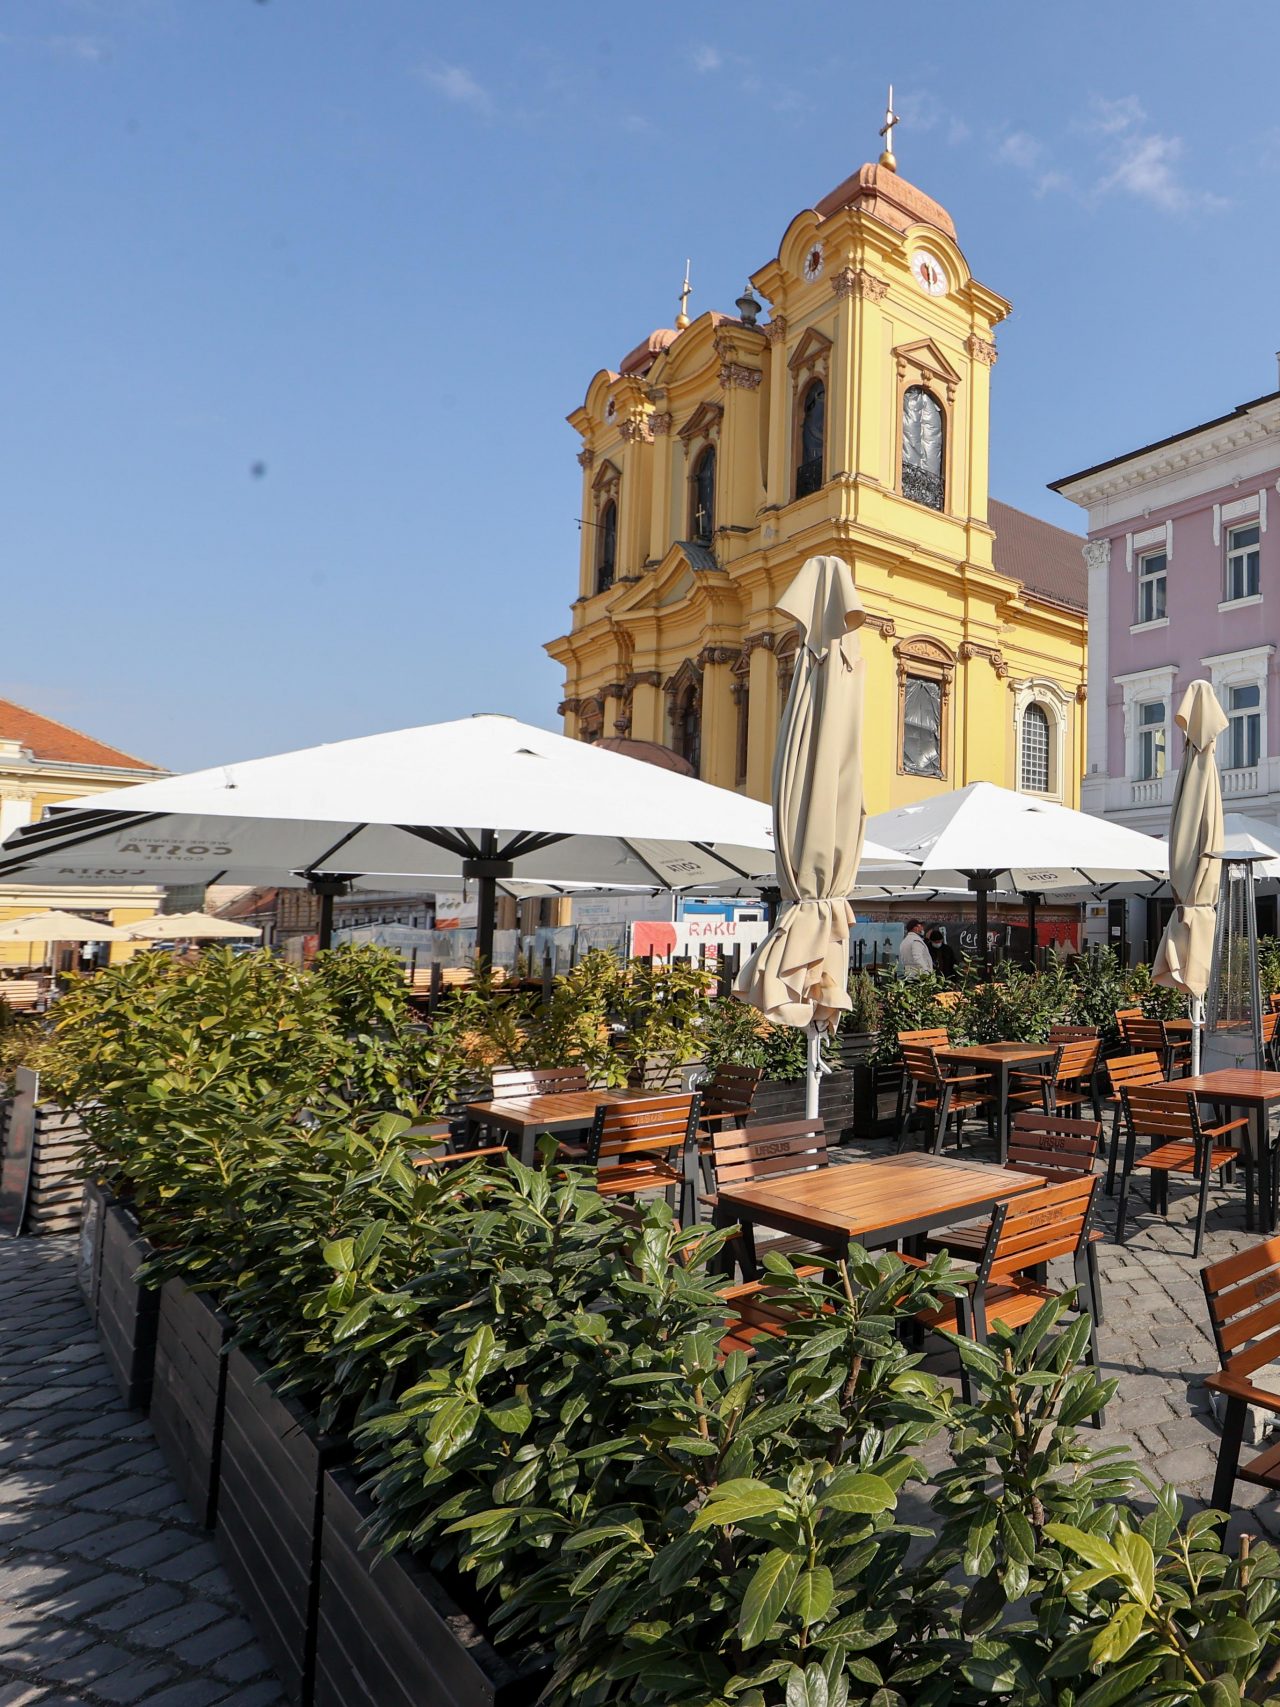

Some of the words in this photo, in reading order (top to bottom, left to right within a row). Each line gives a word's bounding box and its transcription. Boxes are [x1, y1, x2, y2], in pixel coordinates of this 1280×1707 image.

[689, 922, 737, 936] RAKU
[755, 1142, 791, 1155] URSUS
[1039, 1136, 1065, 1148] URSUS
